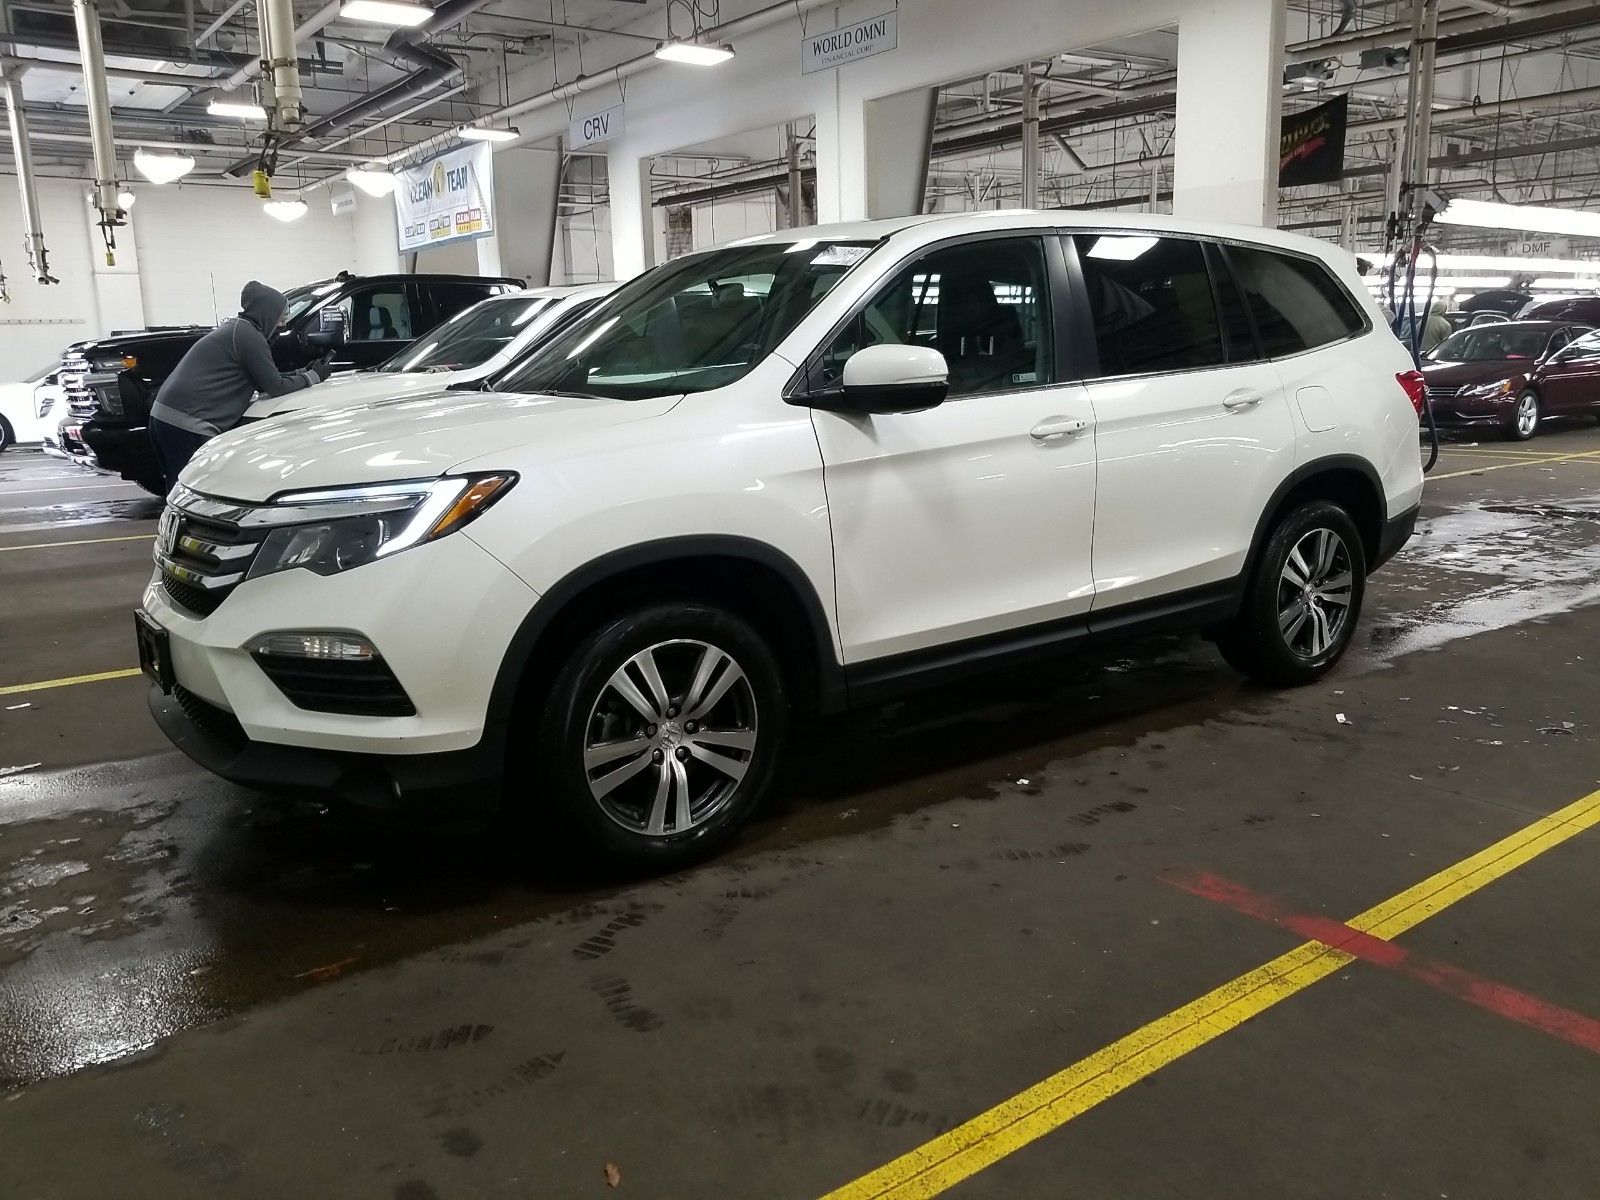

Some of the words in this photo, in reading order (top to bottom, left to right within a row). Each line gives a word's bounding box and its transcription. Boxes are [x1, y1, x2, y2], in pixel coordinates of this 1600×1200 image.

[813, 31, 852, 57] WORLD
[855, 20, 886, 44] OMNI
[821, 50, 855, 65] FINANCIAL
[584, 113, 609, 140] CRV
[411, 178, 433, 204] CLEAN
[447, 166, 468, 193] TEAM
[1523, 241, 1551, 253] DMF
